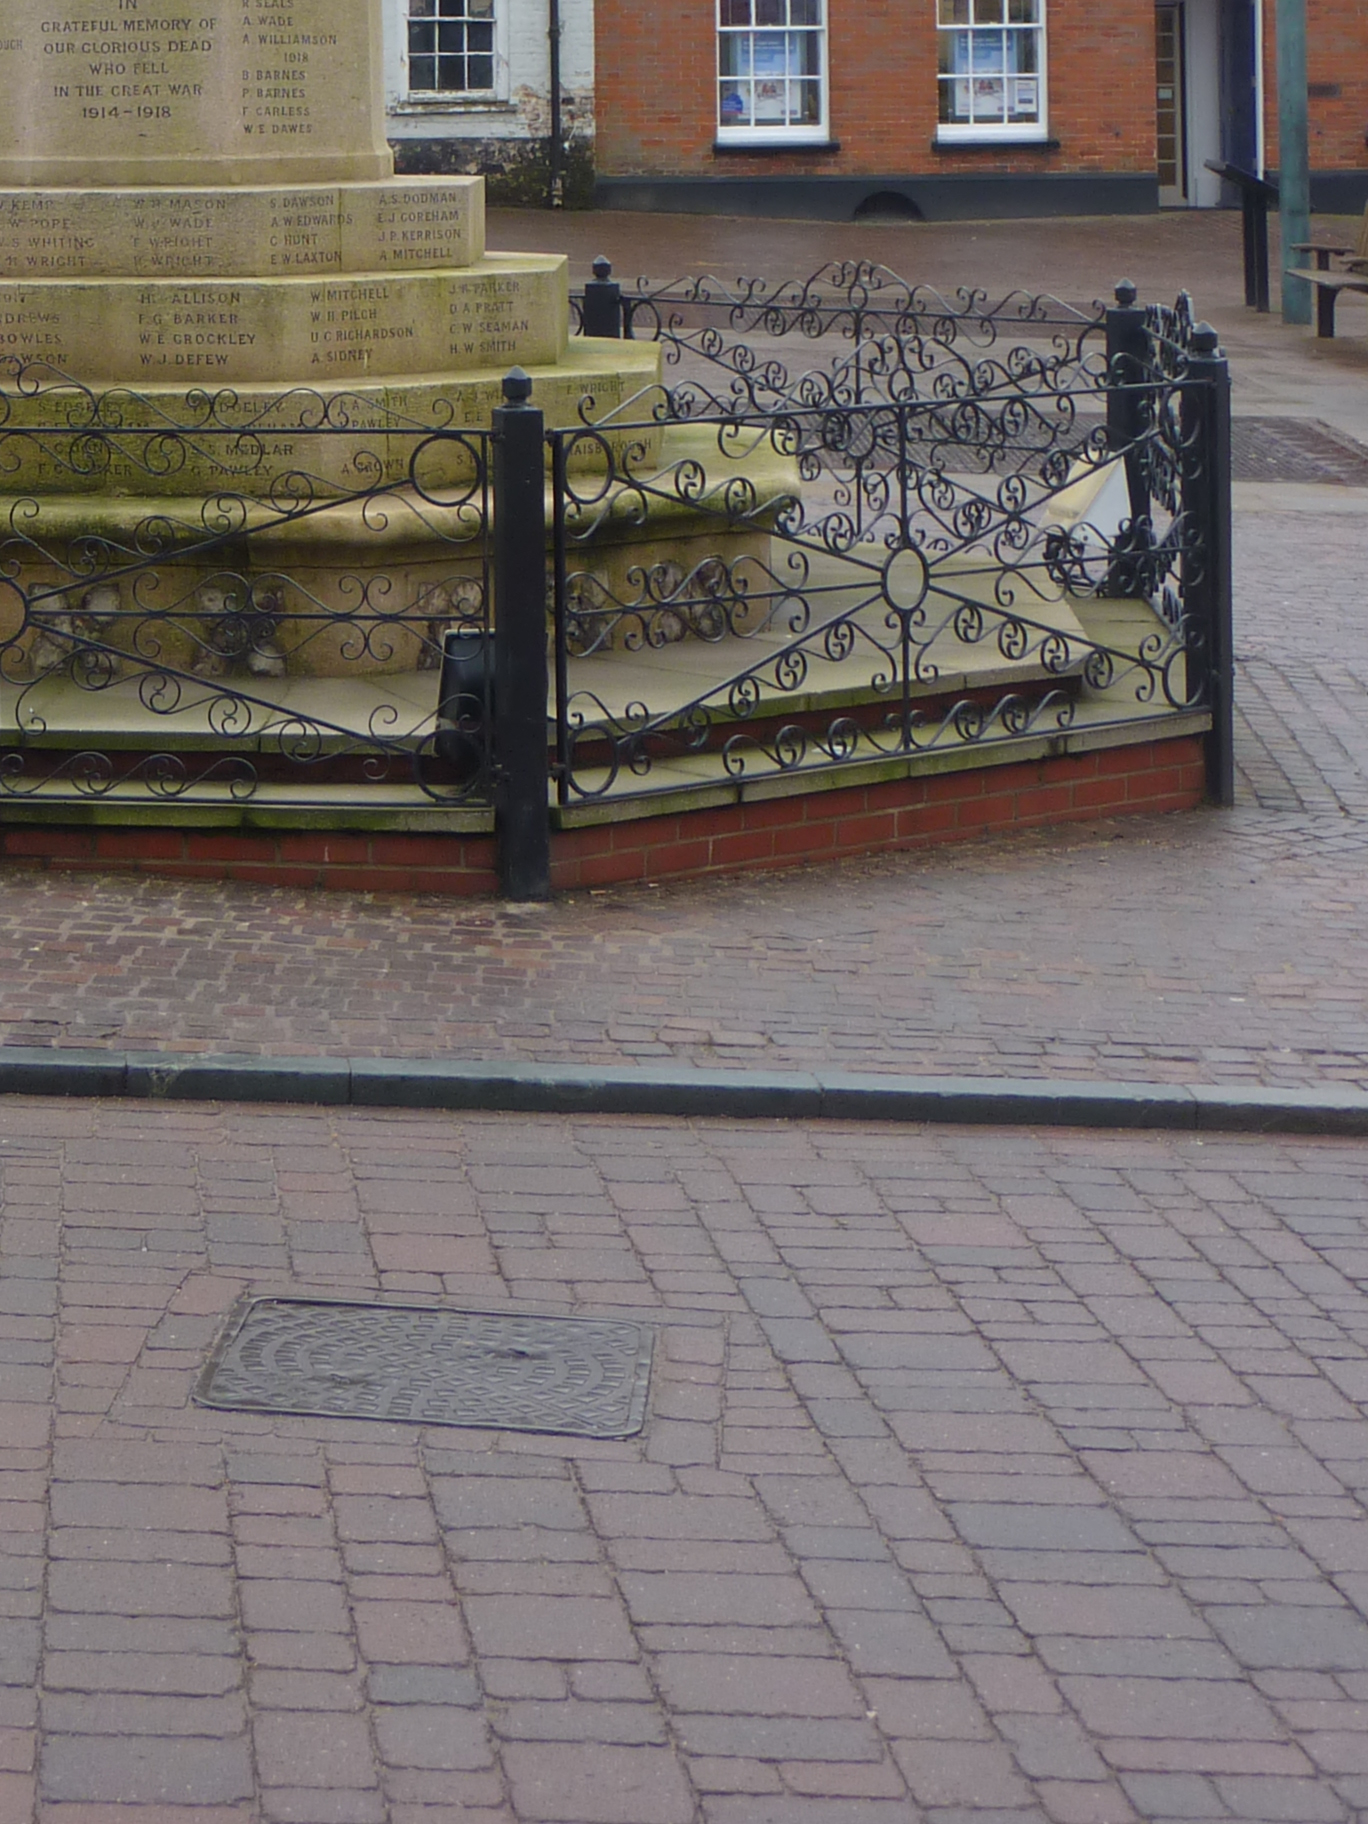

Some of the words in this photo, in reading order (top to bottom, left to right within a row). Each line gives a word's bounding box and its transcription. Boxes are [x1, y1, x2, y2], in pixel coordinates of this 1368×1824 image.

[41, 20, 118, 33] GRATEFUL
[123, 19, 192, 32] MEMORY
[199, 18, 218, 30] OF
[257, 16, 294, 26] WADE
[258, 34, 337, 45] WILLIAMSON
[43, 42, 75, 55] OUR
[82, 41, 161, 54] GLORIOUS
[168, 40, 212, 53] DEAD
[89, 63, 126, 75] WHO
[133, 62, 169, 75] FELL
[256, 70, 306, 81] BARNES
[53, 85, 69, 97] IN
[75, 85, 103, 97] THE
[111, 85, 161, 97] GREAT
[168, 84, 204, 96] WAR
[257, 88, 306, 99] BARNES
[256, 107, 310, 117] CARLESS
[272, 124, 312, 134] DAWES
[283, 196, 334, 208] DAWSON
[404, 192, 457, 205] DODMAN
[170, 218, 213, 228] WADE
[297, 213, 353, 226] EDWARDS
[284, 234, 318, 246] HUNT
[402, 229, 461, 241] KERRISON
[296, 251, 342, 263] LAXTON
[394, 248, 453, 260] MITCHELL
[27, 256, 85, 266] WRIGHT
[172, 292, 241, 304] ALLISON
[327, 288, 389, 301] MITCHELL
[174, 314, 238, 324] BARKER
[479, 320, 529, 333] SEAMAN
[336, 327, 414, 342] RICHARDSON
[480, 341, 516, 354] SMITH
[175, 354, 229, 365] DEFEW
